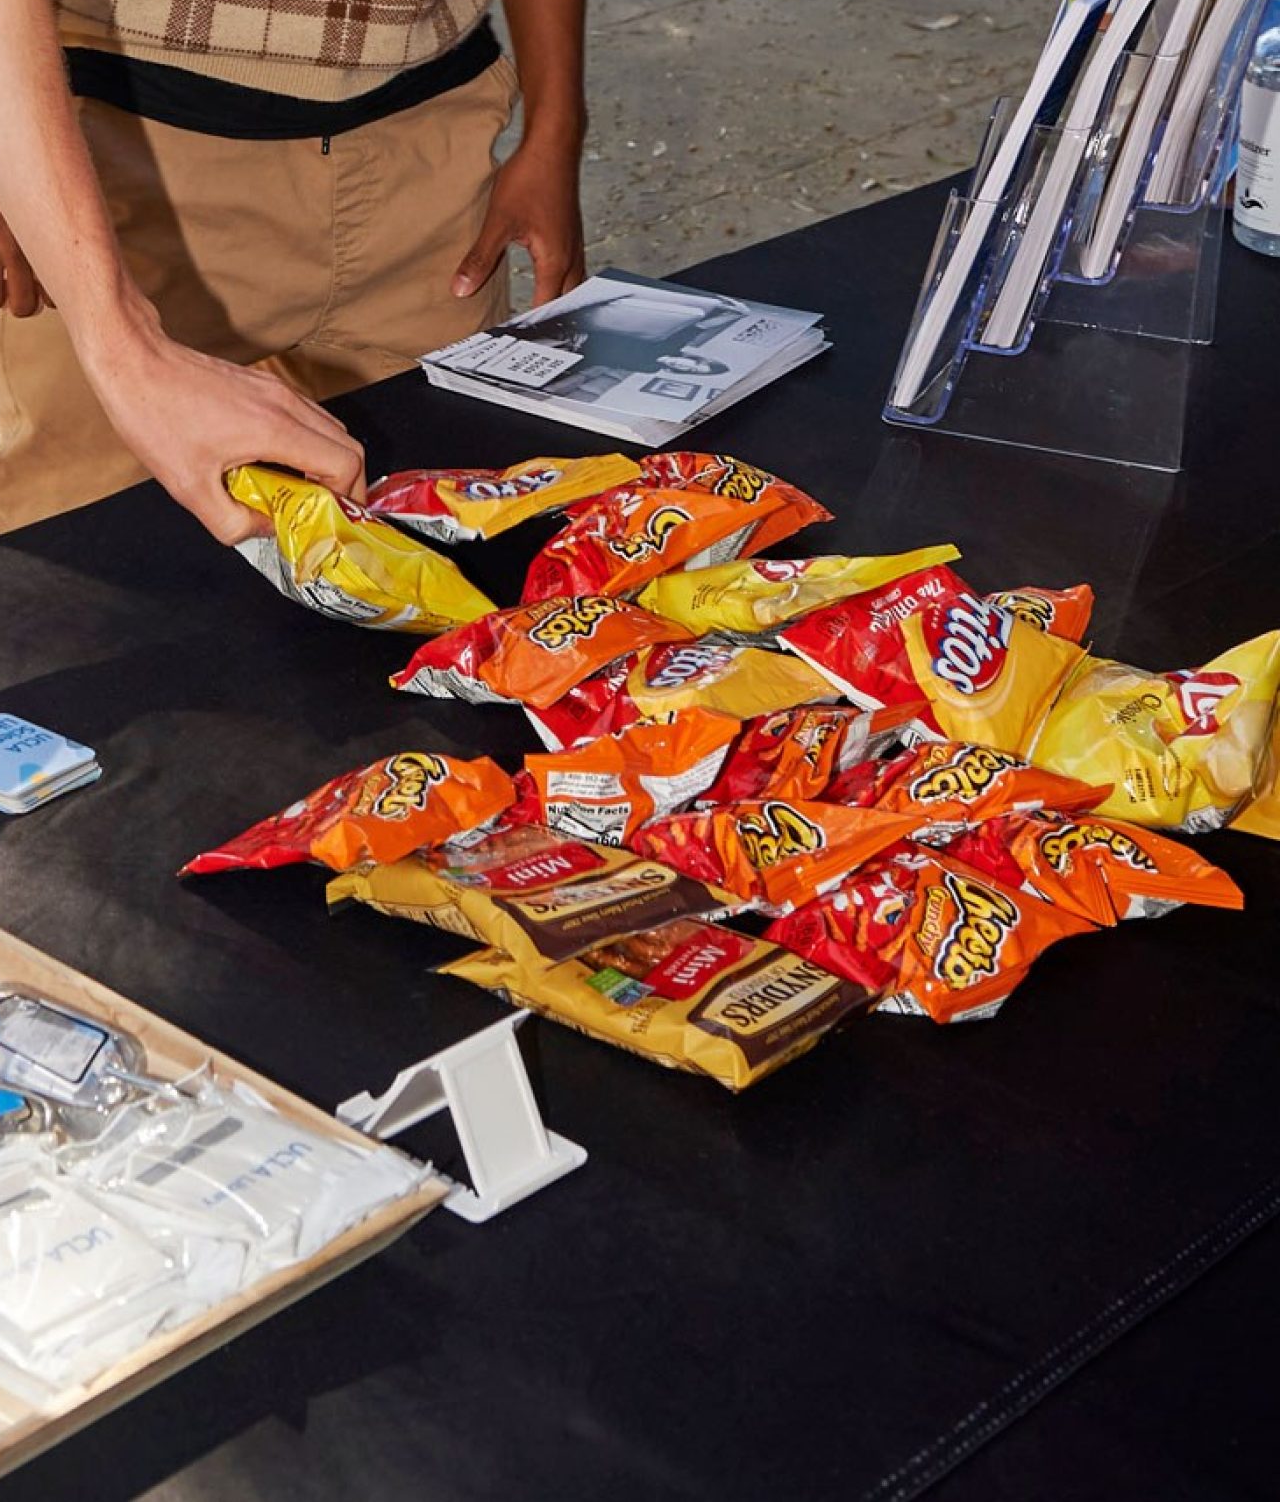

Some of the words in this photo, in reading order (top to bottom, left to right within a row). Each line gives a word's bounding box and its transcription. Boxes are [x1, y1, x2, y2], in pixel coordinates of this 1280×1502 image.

[5, 732, 54, 753] UCLA
[506, 853, 572, 886] Mini
[672, 944, 727, 987] Mini
[250, 1142, 313, 1179] UCLA
[44, 1226, 114, 1263] UCLA
